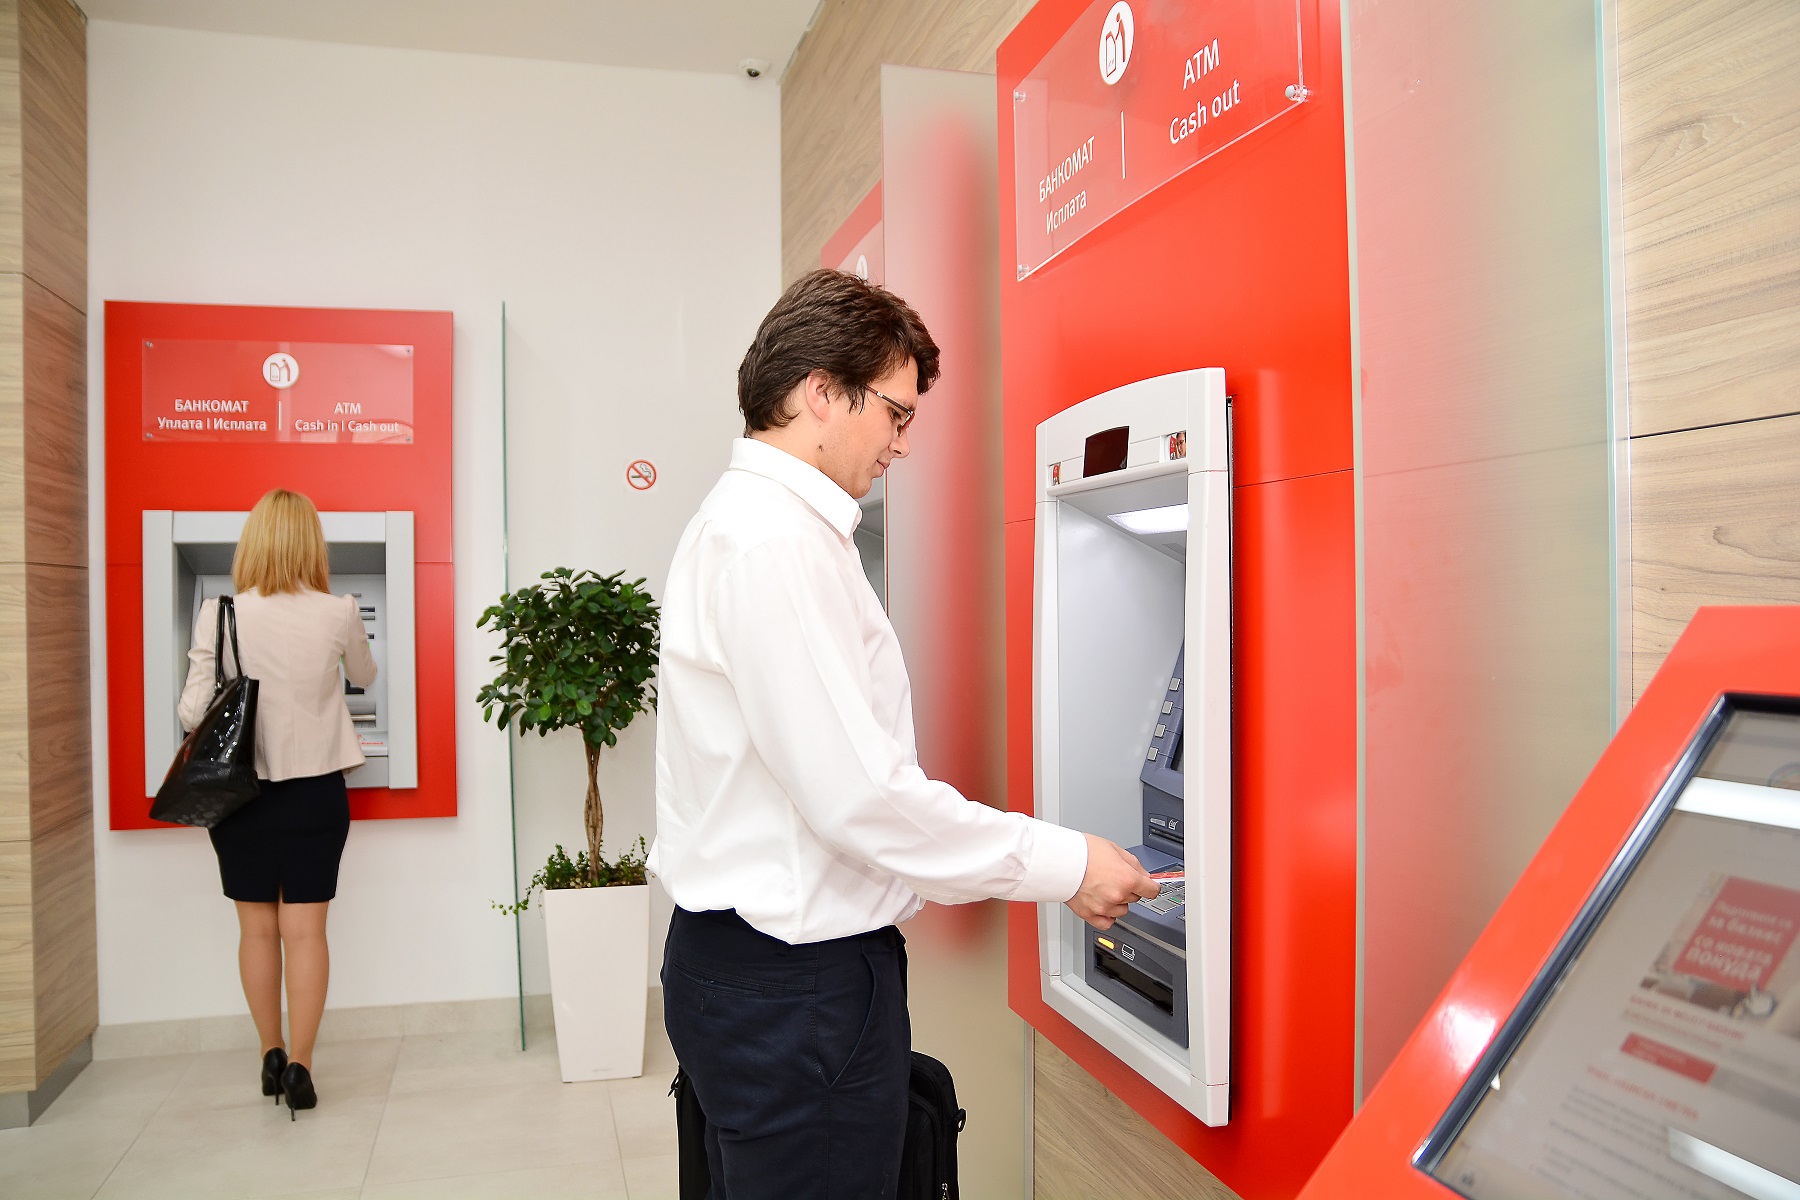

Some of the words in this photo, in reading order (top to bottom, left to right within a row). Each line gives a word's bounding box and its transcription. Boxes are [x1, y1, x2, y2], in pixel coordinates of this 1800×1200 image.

[1183, 38, 1221, 91] ATM
[1169, 101, 1207, 145] Cash
[1211, 78, 1241, 118] out
[1038, 136, 1096, 204] БАНКОМАТ
[1045, 189, 1088, 236] Исплата
[174, 399, 249, 413] БАНКОМАТ
[334, 402, 361, 415] ATM
[157, 416, 203, 430] Уплата
[213, 418, 267, 431] Исплата
[295, 419, 324, 432] Cash
[327, 420, 338, 432] in
[348, 420, 376, 432] Cash
[379, 423, 399, 433] out
